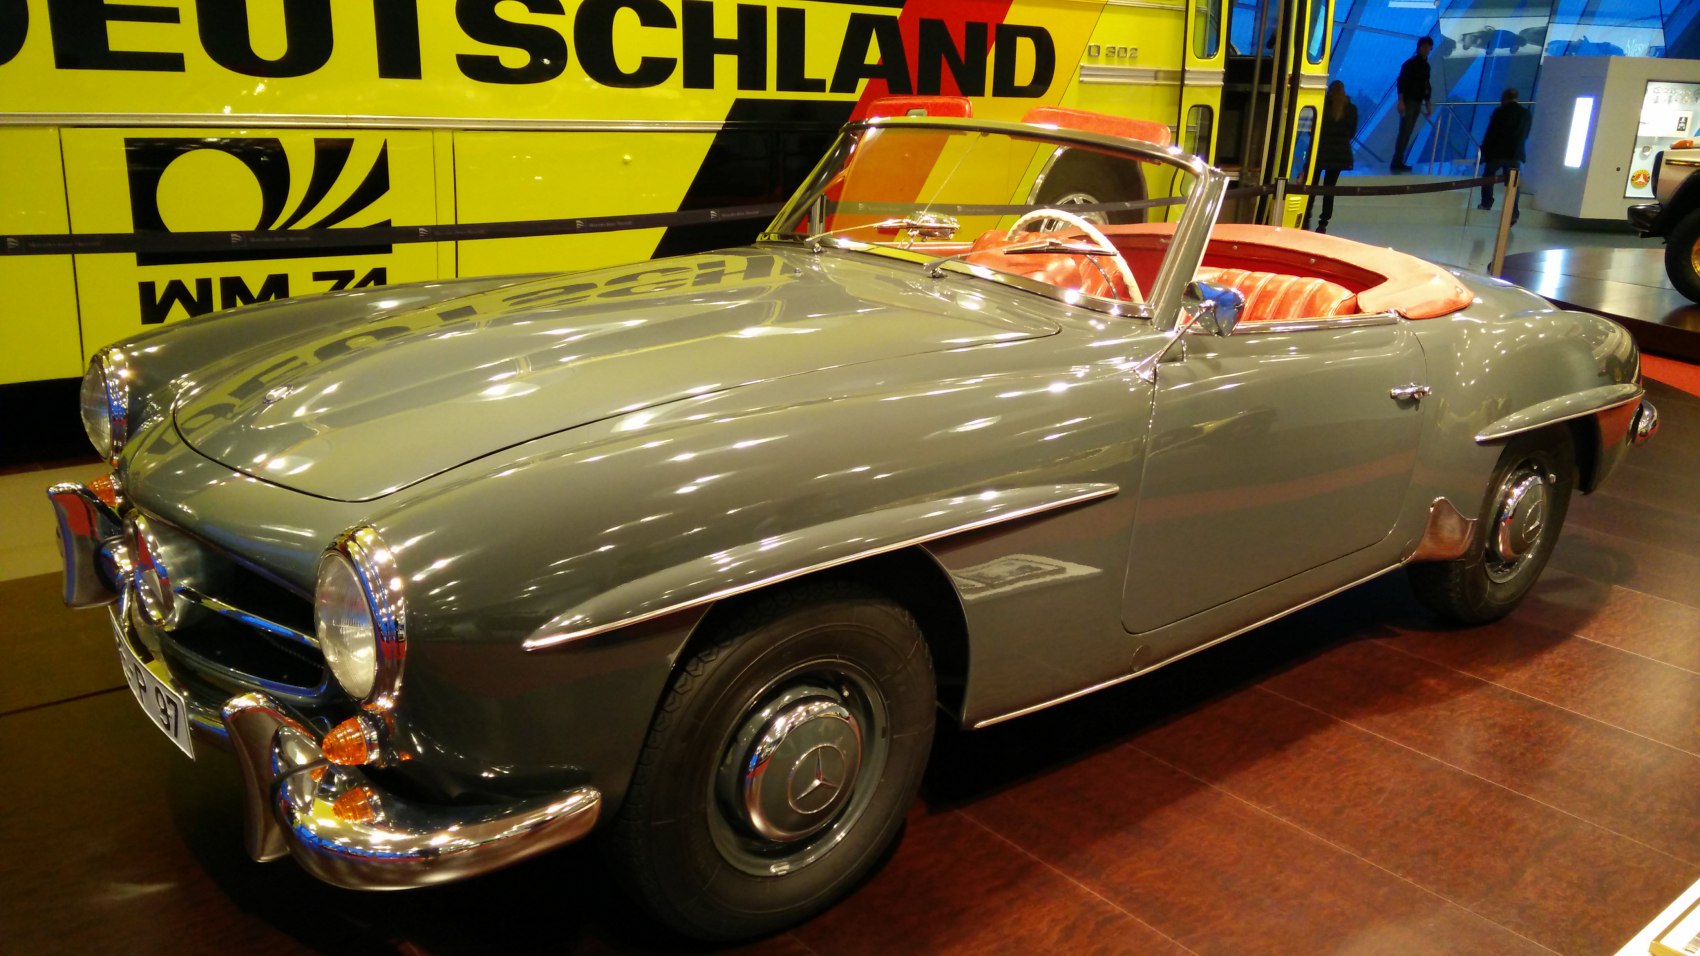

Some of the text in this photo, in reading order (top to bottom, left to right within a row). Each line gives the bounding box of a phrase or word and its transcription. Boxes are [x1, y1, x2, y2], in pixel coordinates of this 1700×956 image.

[0, 0, 1056, 98] EUTSCHLAND
[1105, 46, 1138, 58] 302
[138, 273, 289, 325] WM
[155, 686, 179, 738] 97
